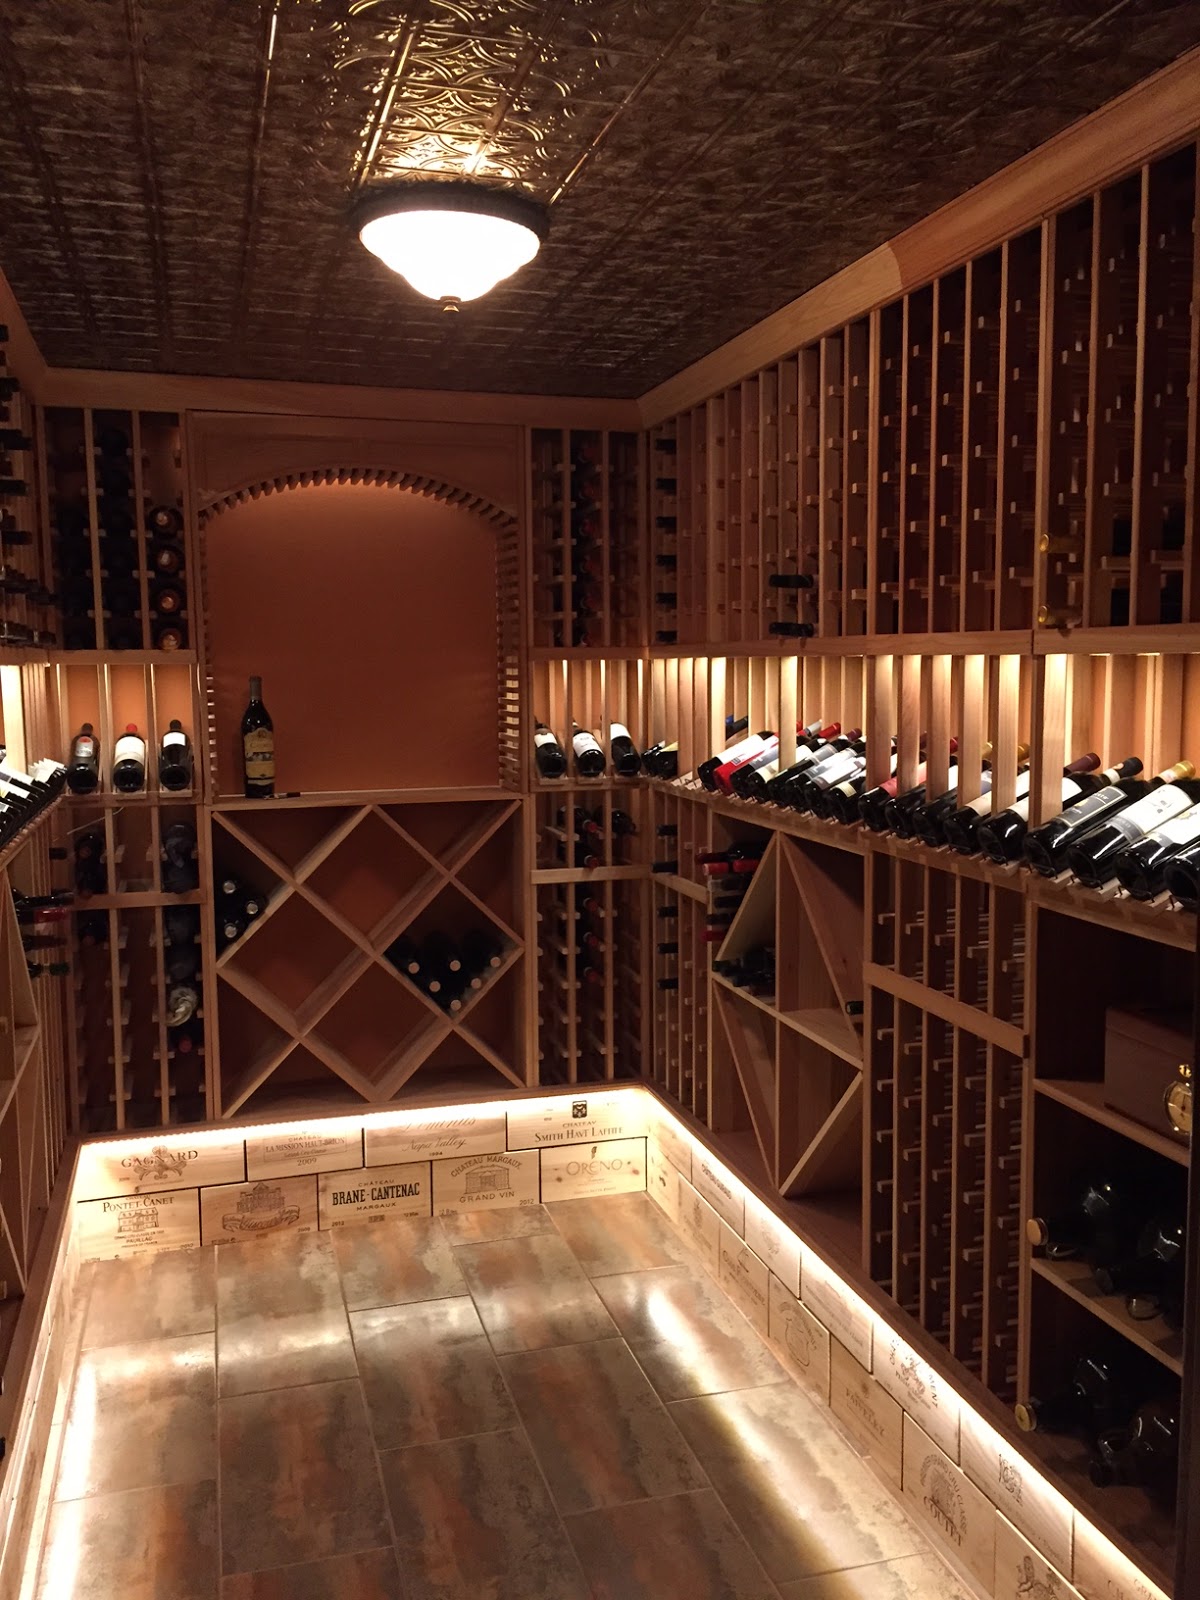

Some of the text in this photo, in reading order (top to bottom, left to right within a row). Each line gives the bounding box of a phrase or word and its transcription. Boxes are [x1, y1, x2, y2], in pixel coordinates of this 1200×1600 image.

[276, 1142, 304, 1151] MISSION
[434, 1134, 466, 1150] Valley
[121, 1149, 199, 1168] GAGNARD
[297, 1158, 317, 1166] 2009
[486, 1155, 523, 1170] MARGAUX
[566, 1158, 623, 1176] ORENO
[459, 1190, 515, 1203] GRAND VIN
[519, 1198, 535, 1206] 2012
[356, 1201, 397, 1211] MARGAUX
